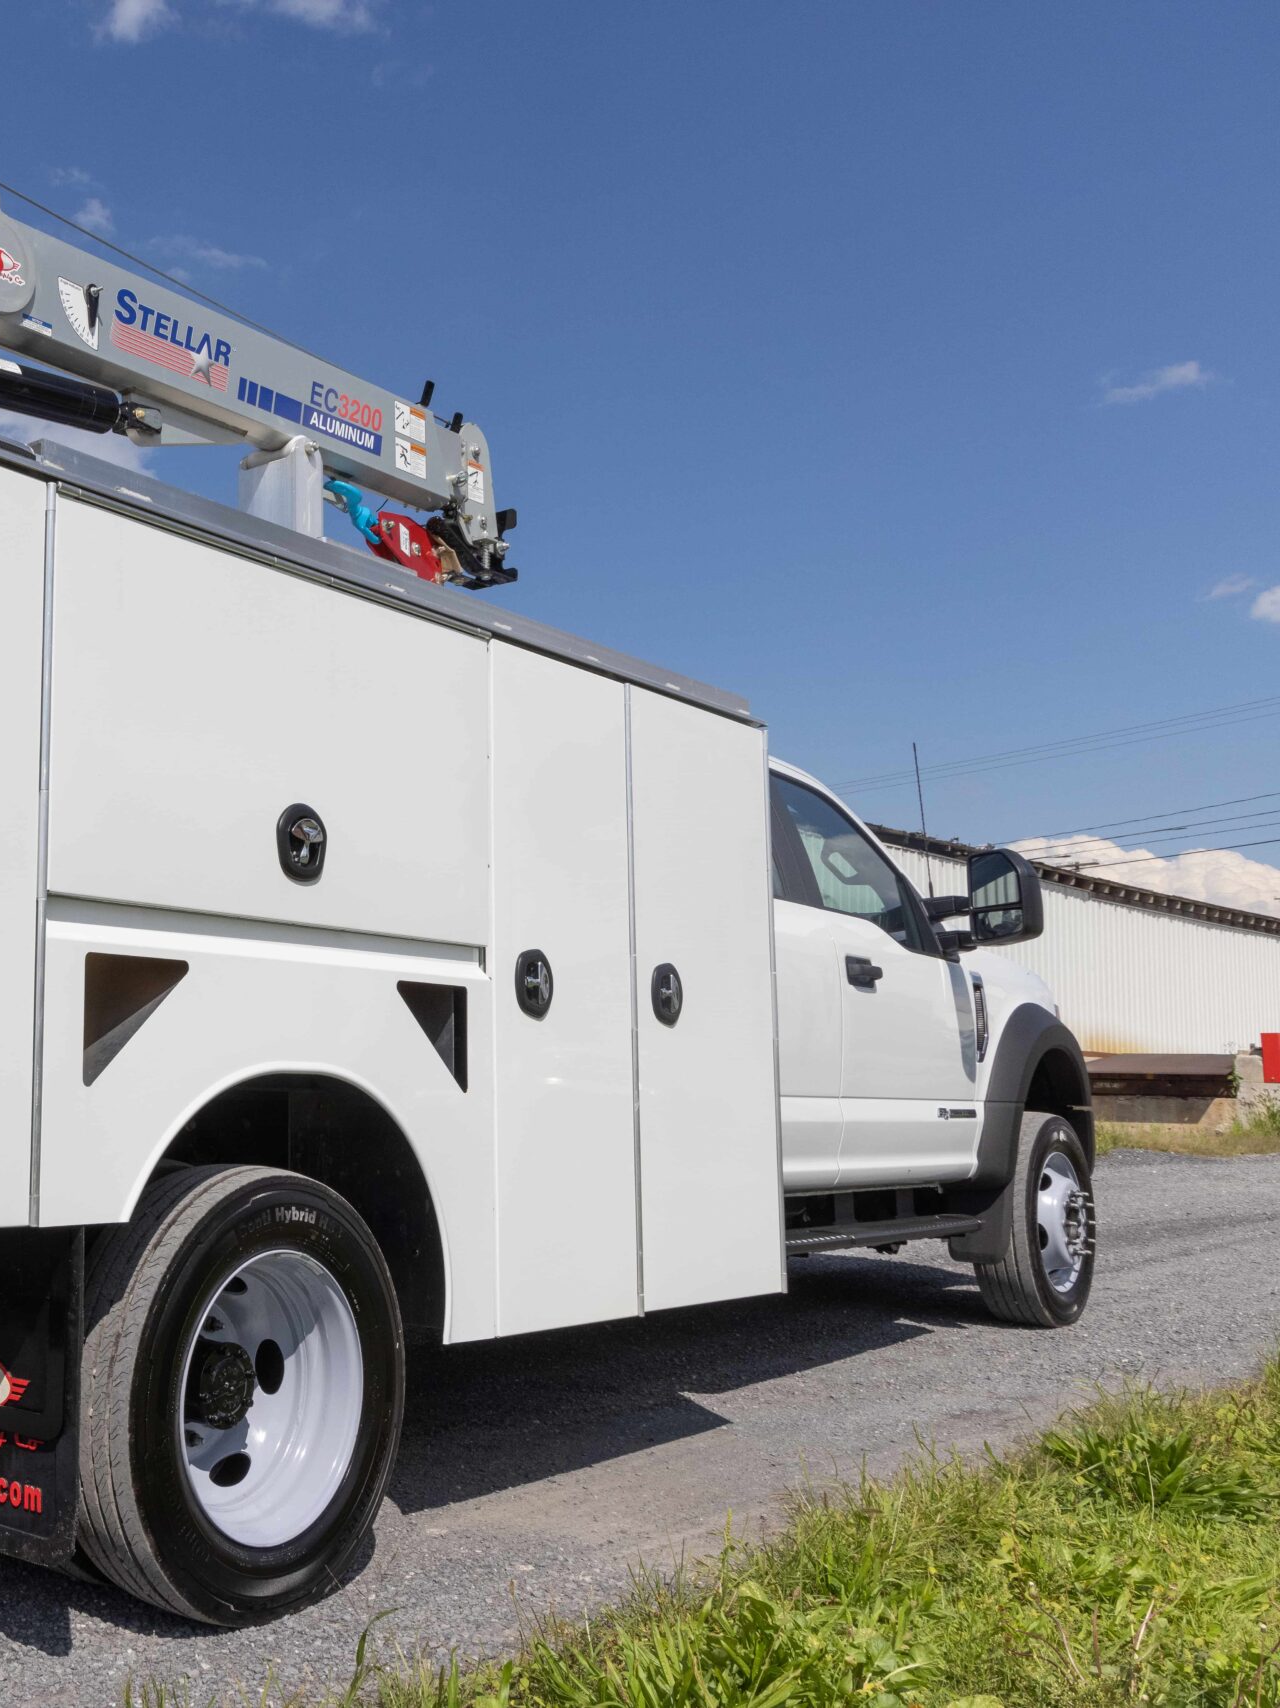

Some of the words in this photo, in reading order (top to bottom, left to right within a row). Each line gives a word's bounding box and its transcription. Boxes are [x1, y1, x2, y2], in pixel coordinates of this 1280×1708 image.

[114, 288, 232, 368] STELLAR
[310, 380, 383, 433] EC3200
[309, 411, 376, 450] ALUMINUM
[274, 1205, 318, 1225] Hybrid
